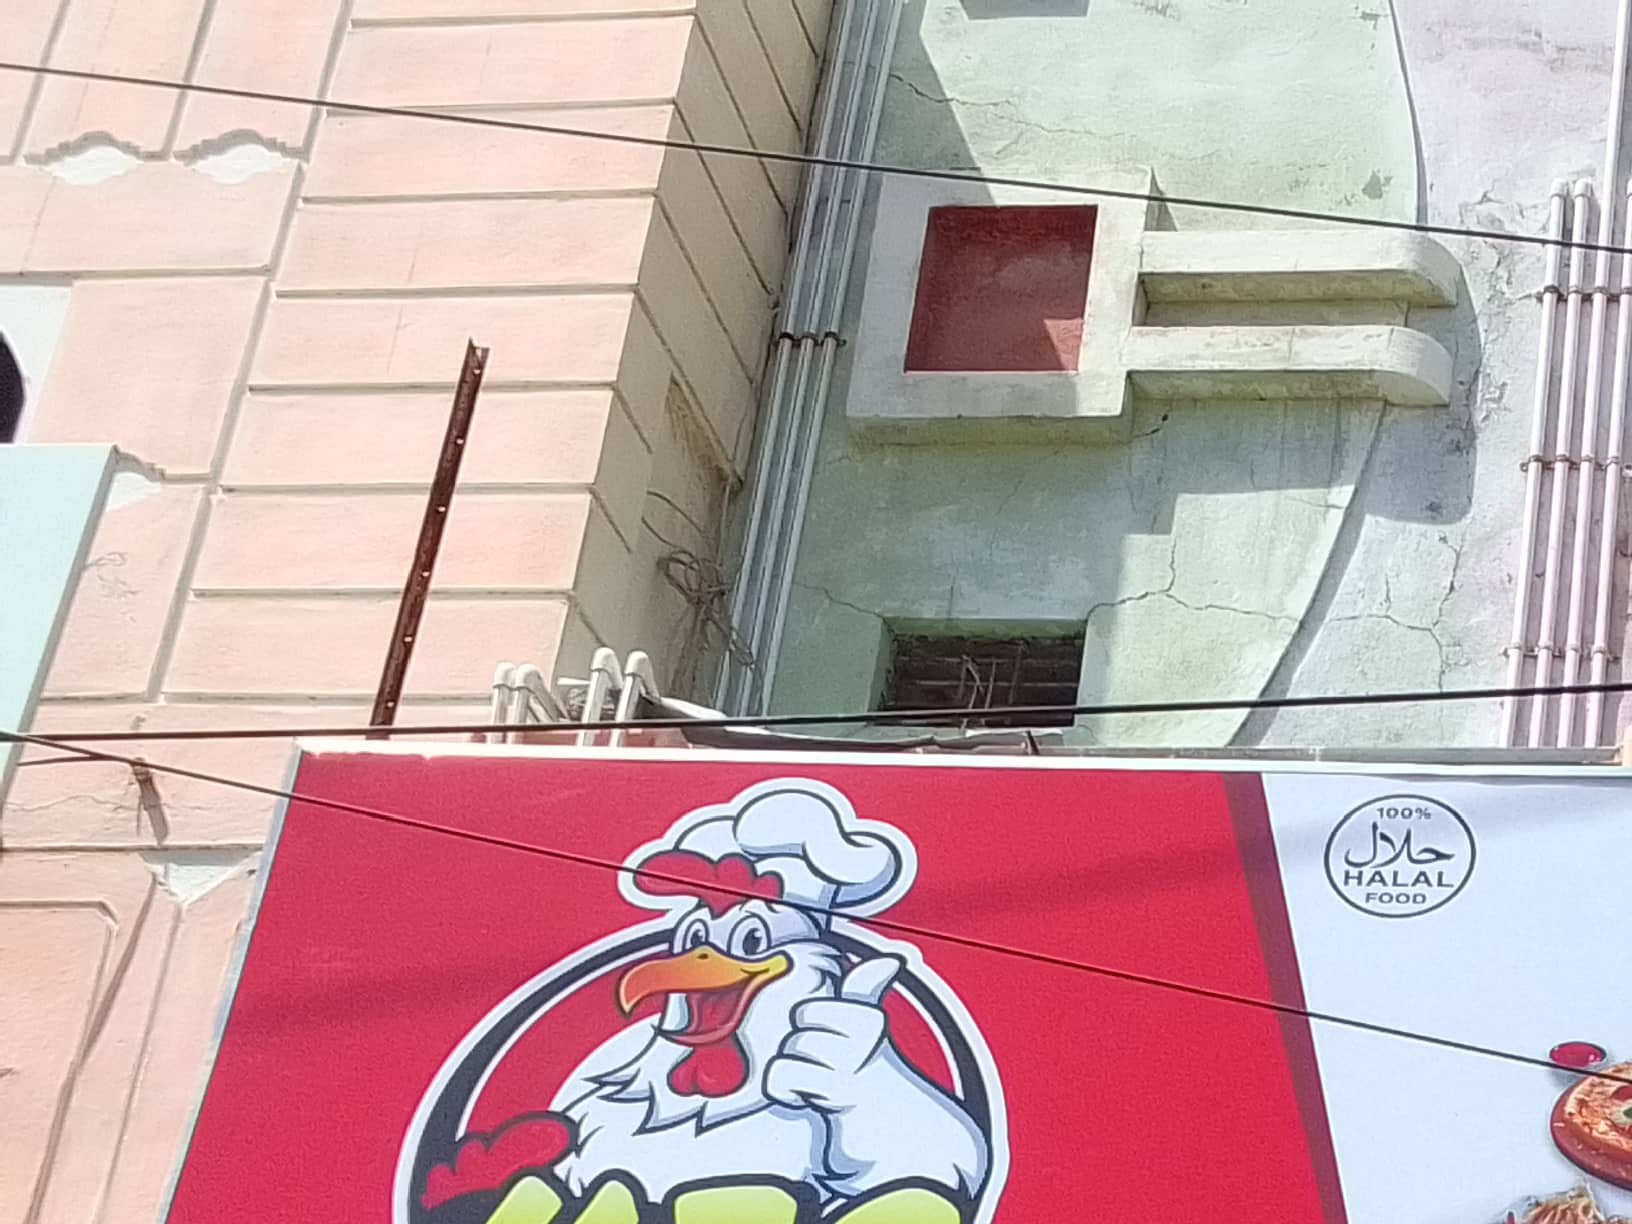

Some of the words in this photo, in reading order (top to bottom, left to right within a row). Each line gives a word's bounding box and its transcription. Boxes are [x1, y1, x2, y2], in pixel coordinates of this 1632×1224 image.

[1376, 807, 1432, 820] 100%
[1343, 870, 1455, 888] HALAL
[1365, 892, 1427, 905] FOOD
